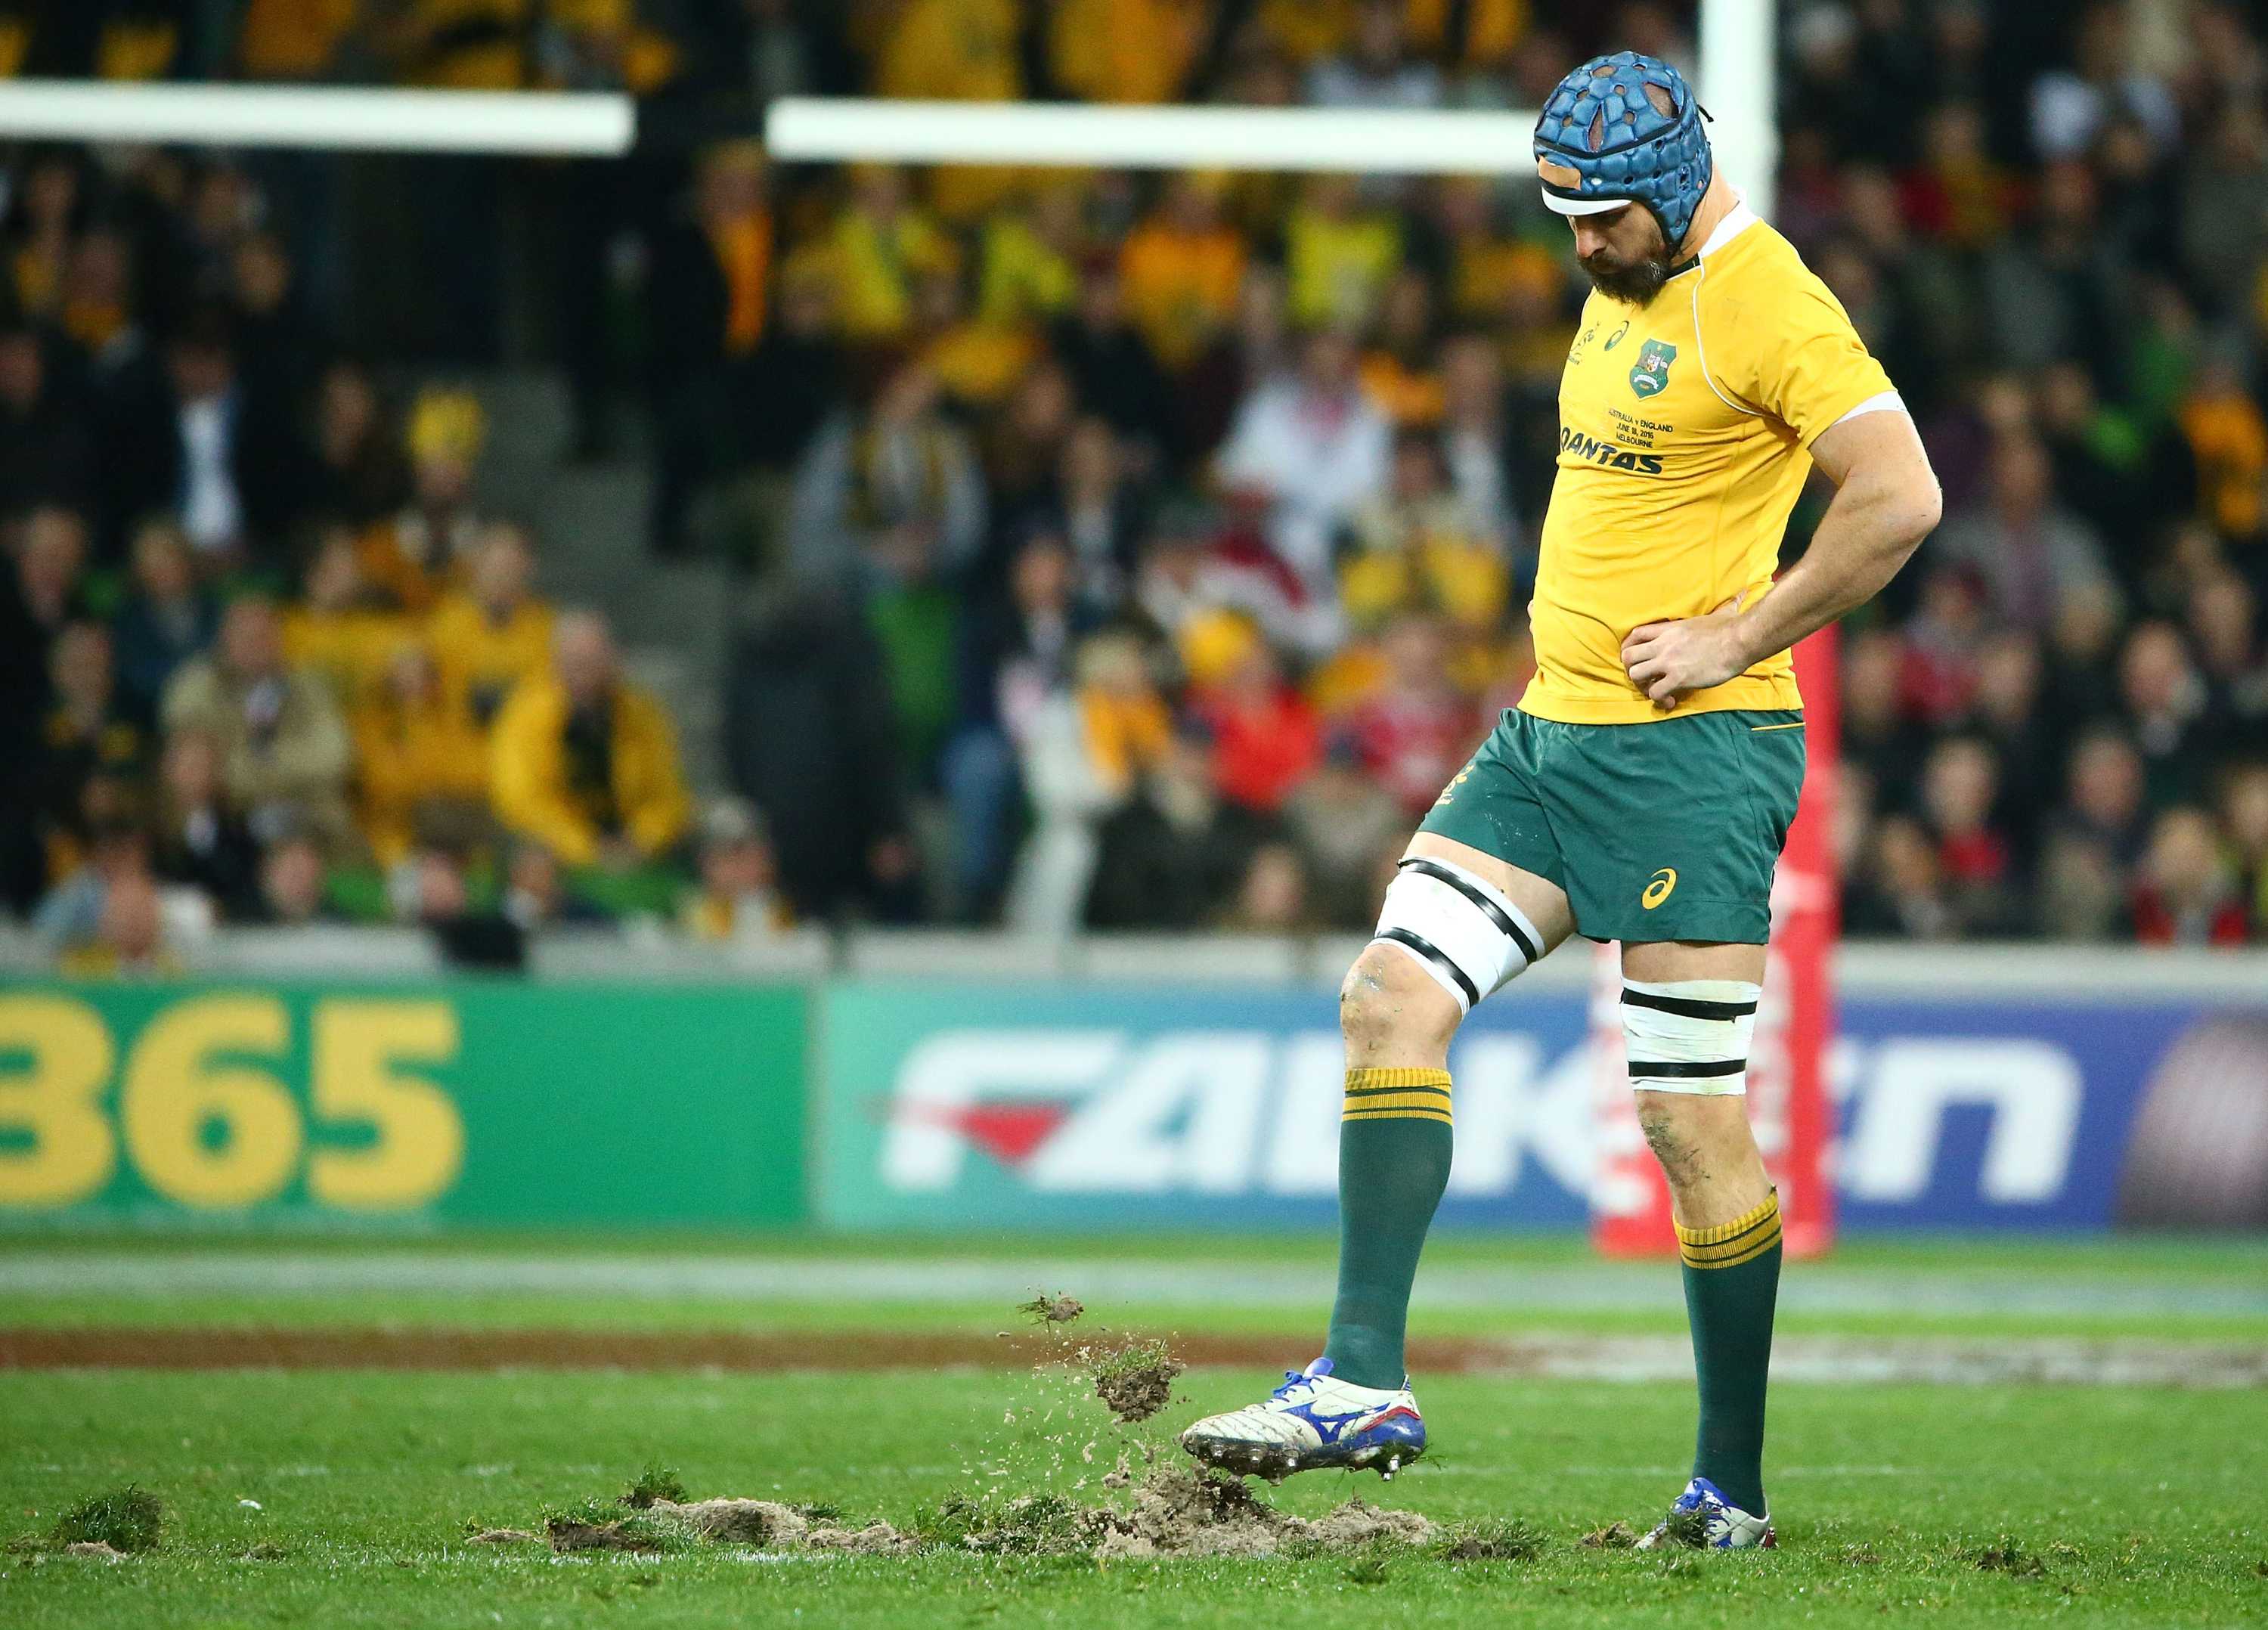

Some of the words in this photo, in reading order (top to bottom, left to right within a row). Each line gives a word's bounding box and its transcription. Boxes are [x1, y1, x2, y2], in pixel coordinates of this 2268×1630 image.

[1616, 423, 1630, 432] JUNE
[1641, 430, 1654, 439] 2016
[1641, 420, 1673, 432] ENGLAND
[0, 993, 463, 1210] 365
